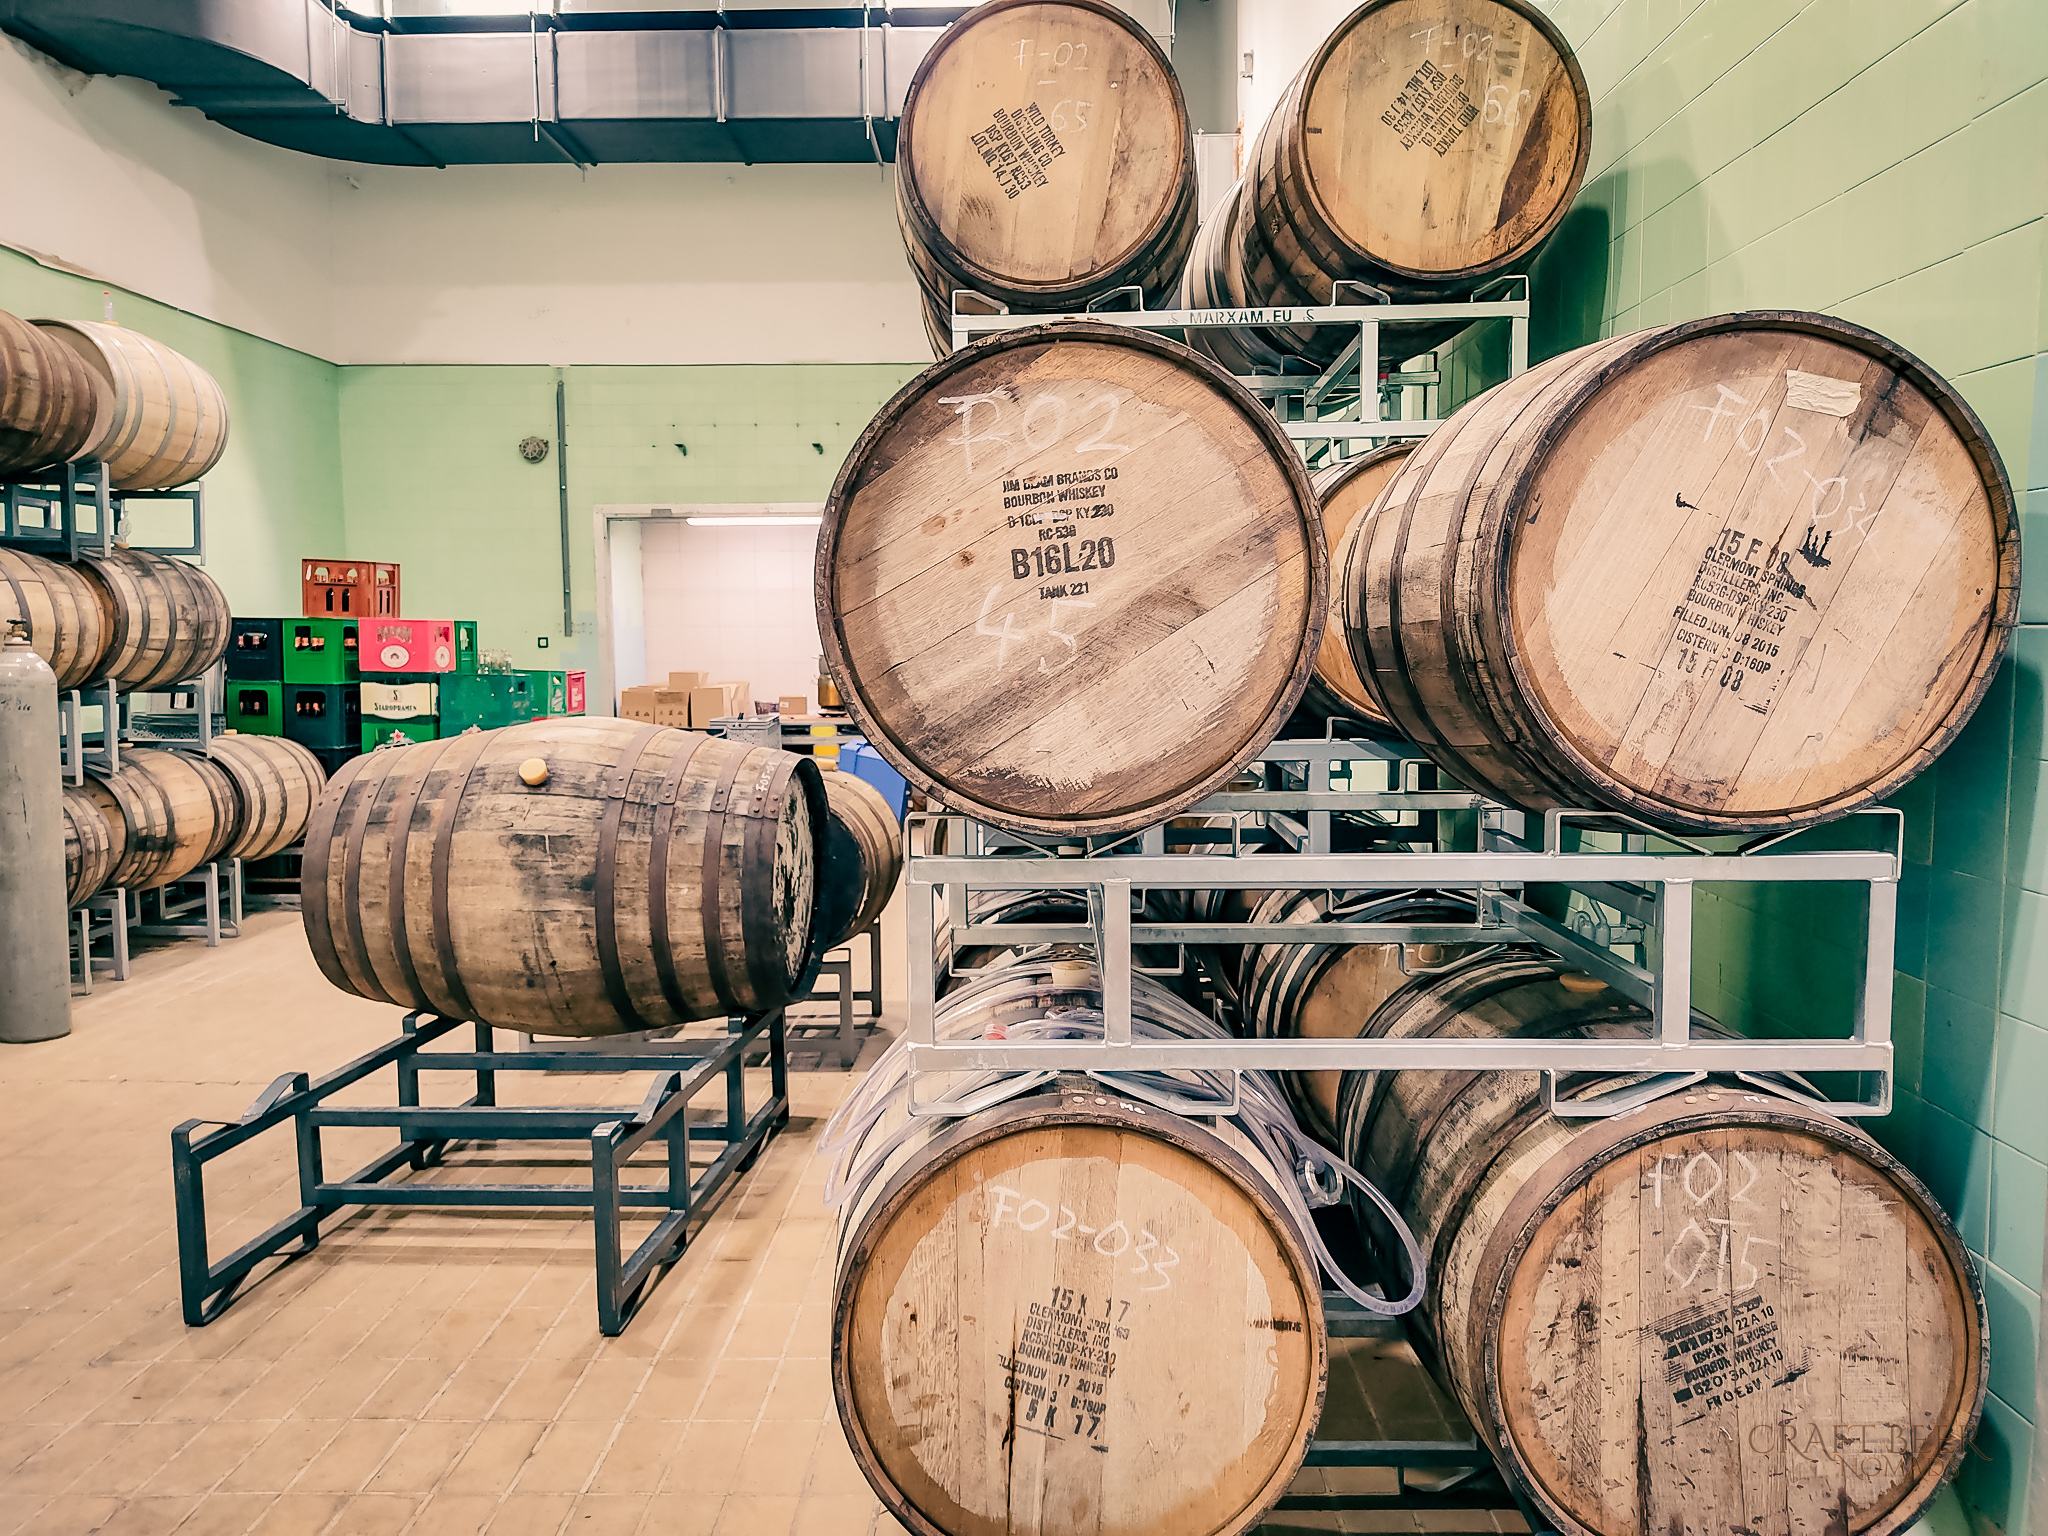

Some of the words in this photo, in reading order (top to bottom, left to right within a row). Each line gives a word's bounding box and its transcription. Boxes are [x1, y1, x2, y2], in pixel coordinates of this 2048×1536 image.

[1428, 73, 1464, 115] BOURBON
[1430, 71, 1448, 91] DSP
[1381, 111, 1396, 126] 30
[1457, 104, 1480, 127] WILD
[1011, 108, 1045, 156] DISTILLING
[1038, 152, 1053, 171] CO.
[1025, 102, 1046, 127] WILD
[1039, 124, 1066, 159] TURKEY
[1433, 124, 1463, 157] TURKEY
[985, 124, 1002, 143] DSP
[996, 141, 1018, 167] KY67
[1011, 165, 1031, 190] RC53
[993, 107, 1026, 151] BOURBON
[1019, 149, 1049, 188] WHISKEY
[1005, 185, 1020, 199] 30
[1190, 309, 1292, 324] MARXAM.EU
[1002, 479, 1020, 493] JIM
[1056, 469, 1102, 486] BRANDS
[1104, 467, 1119, 481] CO
[1003, 491, 1056, 509] BOURBON
[1058, 485, 1106, 502] WHISKEY
[1011, 537, 1115, 580] B16L20
[1719, 528, 1746, 556] 15
[1745, 538, 1763, 561] F
[1705, 546, 1761, 579] CLERMONT
[1038, 584, 1069, 600] TANK
[1070, 582, 1090, 596] 221
[1687, 589, 1737, 619] BOURBON
[1673, 605, 1707, 631] FILLED
[1751, 637, 1780, 658] 2015
[1677, 628, 1720, 654] CISTERN
[989, 1185, 1180, 1291] F02-033
[1052, 1286, 1074, 1311] 15
[1004, 1376, 1047, 1401] CSTERN
[1057, 1374, 1070, 1387] 17
